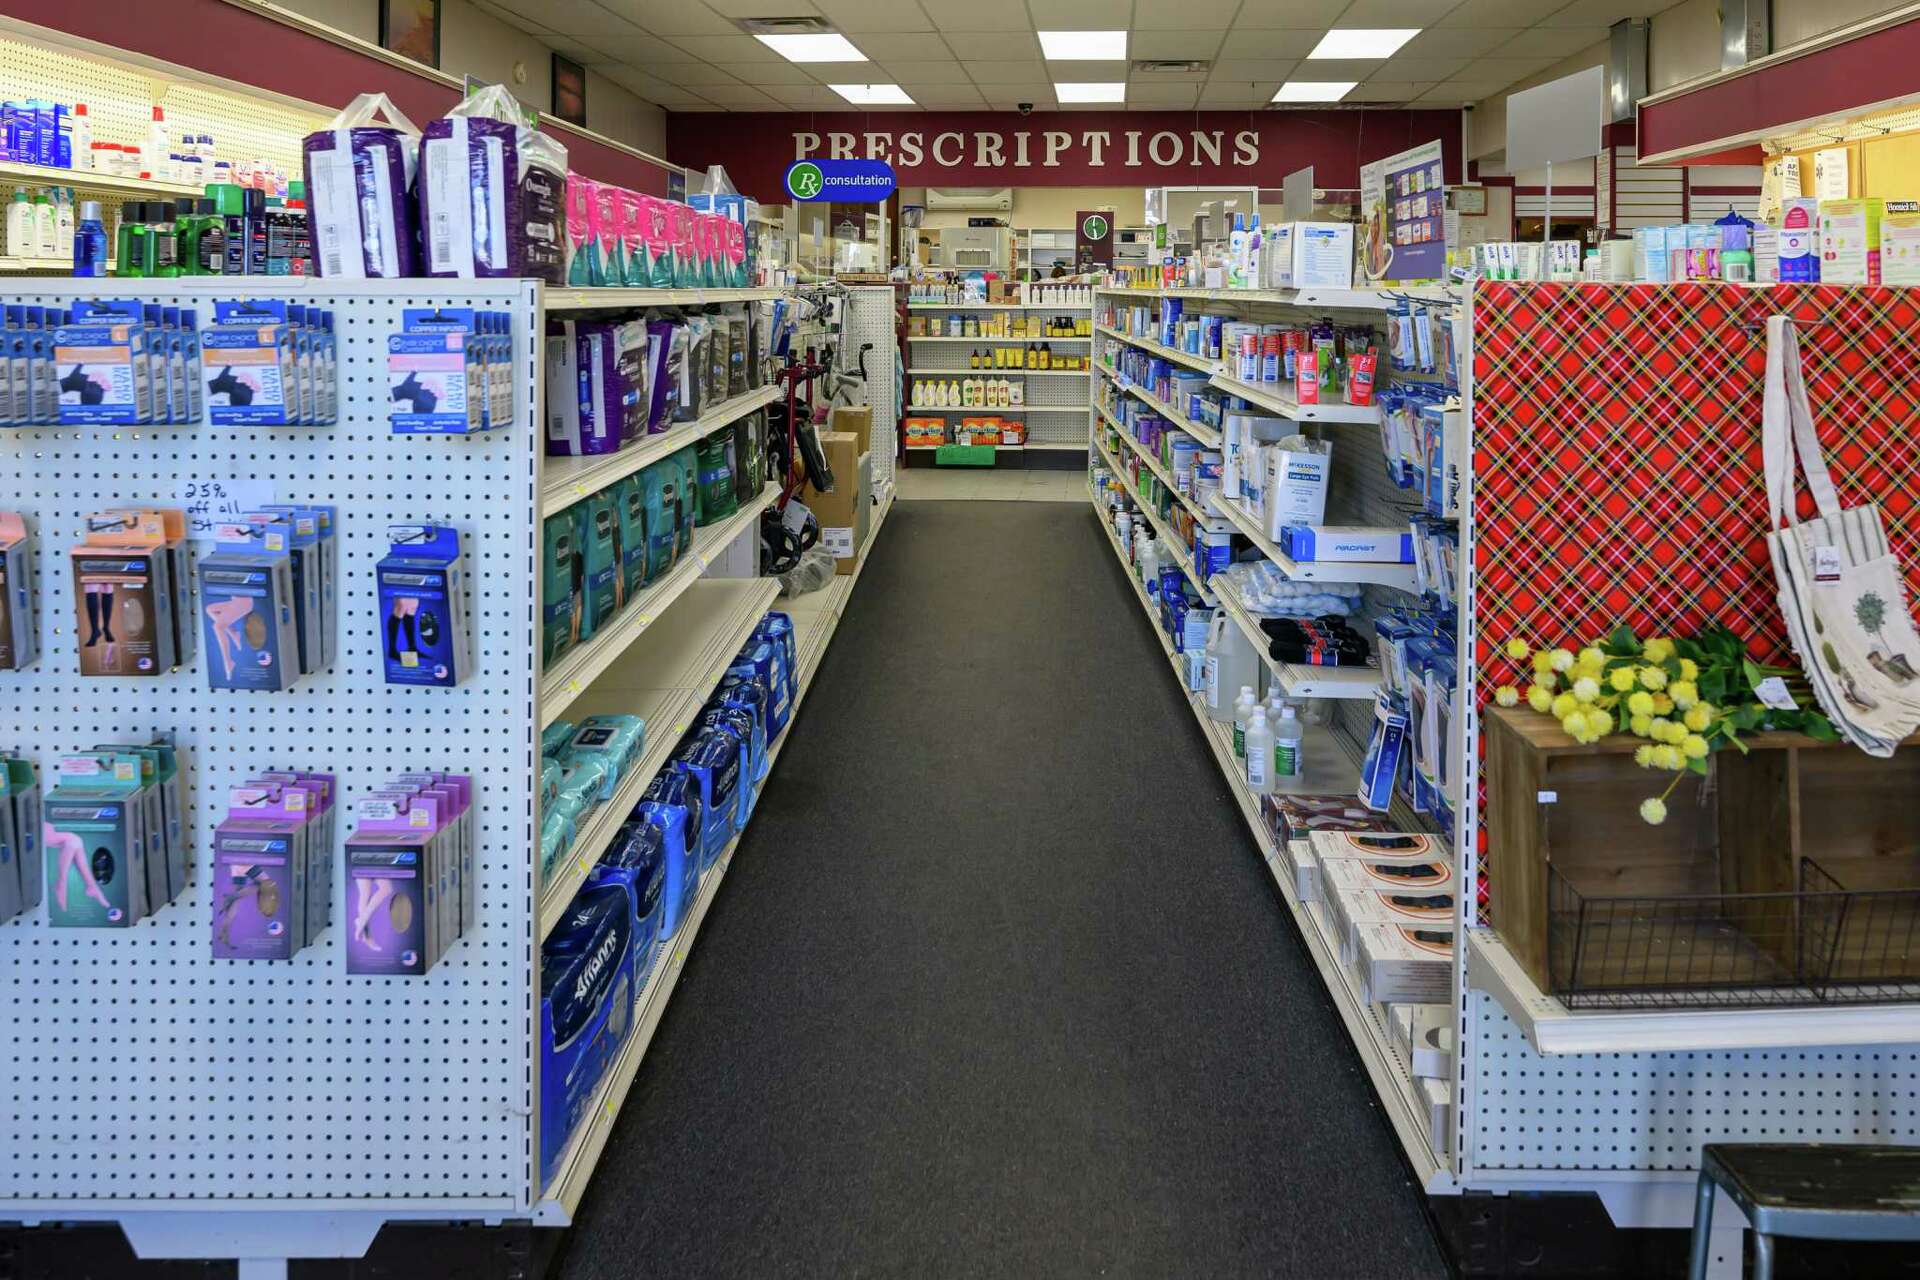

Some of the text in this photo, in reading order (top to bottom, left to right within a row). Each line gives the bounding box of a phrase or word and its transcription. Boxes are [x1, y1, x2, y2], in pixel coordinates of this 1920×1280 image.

[791, 130, 1260, 167] PRESCRIPTIONS
[824, 174, 891, 186] consultation
[185, 483, 227, 498] 25%
[187, 500, 241, 513] off all
